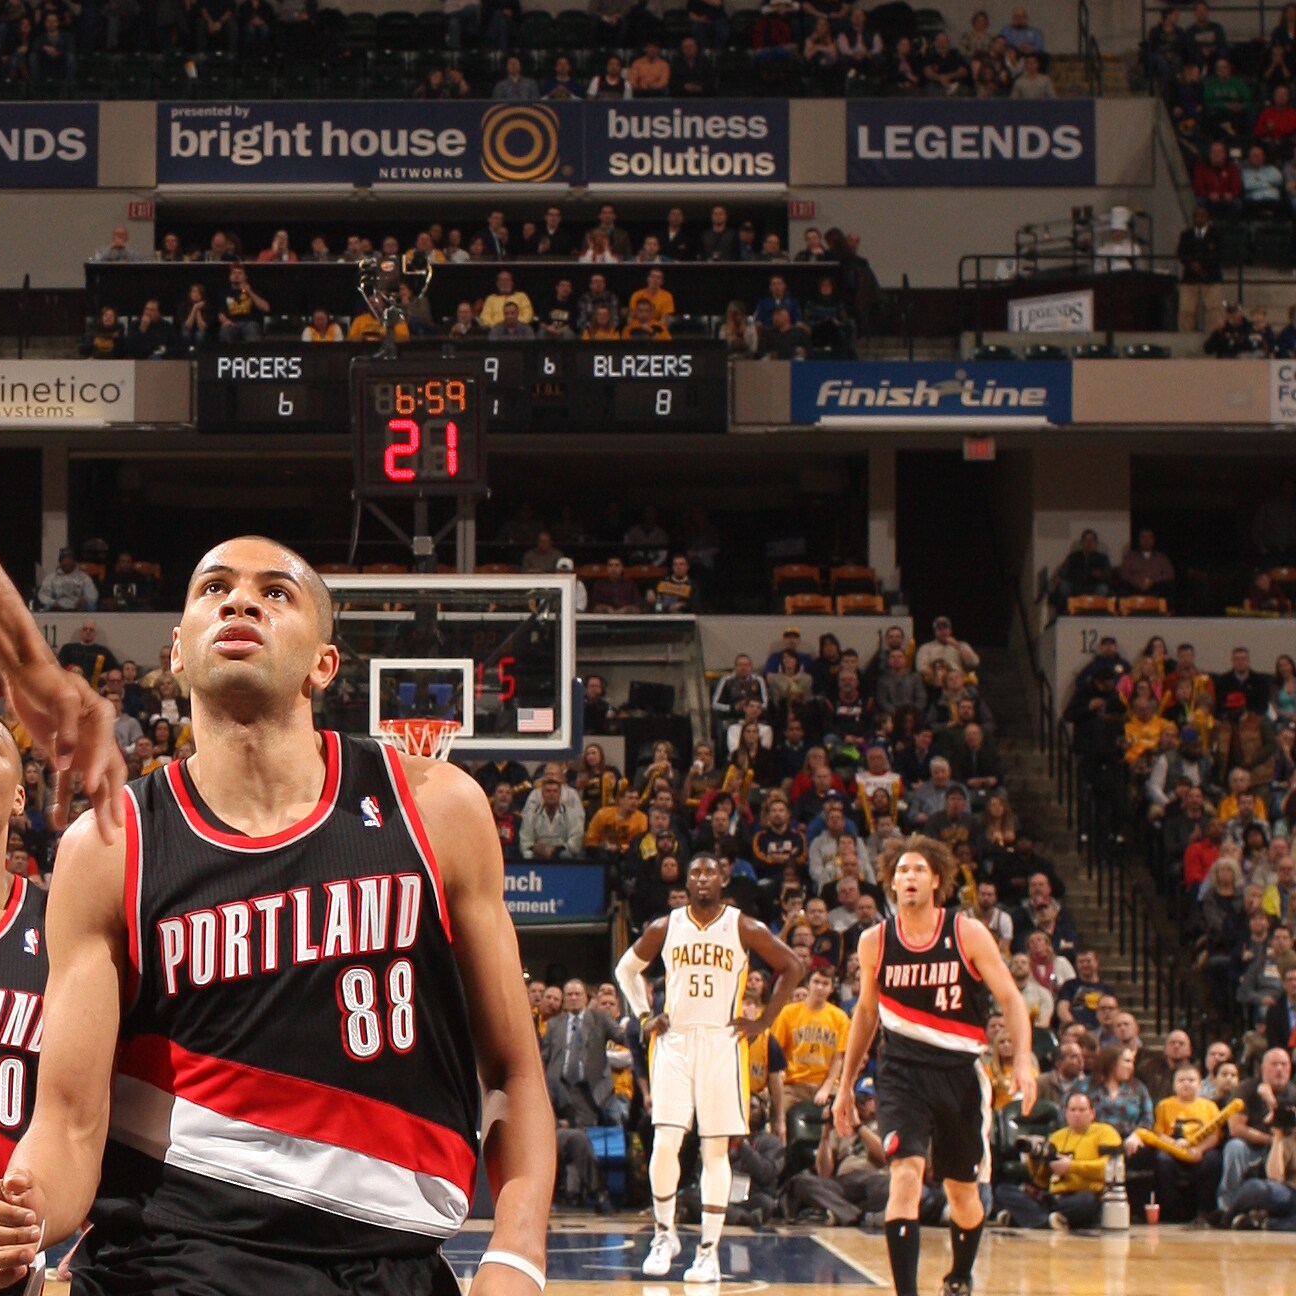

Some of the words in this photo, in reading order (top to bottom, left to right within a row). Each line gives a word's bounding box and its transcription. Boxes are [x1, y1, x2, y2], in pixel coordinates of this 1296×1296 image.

[170, 106, 232, 120] presented
[234, 106, 250, 119] by
[608, 107, 769, 139] business
[170, 120, 312, 165] bright
[321, 120, 467, 158] house
[857, 124, 1083, 161] LEGENDS
[379, 167, 464, 179] NETWORKS
[608, 146, 776, 177] solutions
[217, 357, 302, 379] PACERS
[593, 355, 693, 378] BLAZERS
[278, 392, 294, 416] 6
[655, 389, 672, 416] 8
[395, 380, 466, 415] 6:59
[816, 378, 940, 408] Finish
[384, 418, 459, 482] 21
[1081, 629, 1098, 653] 12
[157, 872, 423, 998] PORTLAND
[671, 943, 734, 973] PACERS
[688, 974, 715, 998] 55
[885, 960, 961, 988] PORTLAND
[335, 956, 415, 1062] 88
[934, 986, 963, 1012] 42
